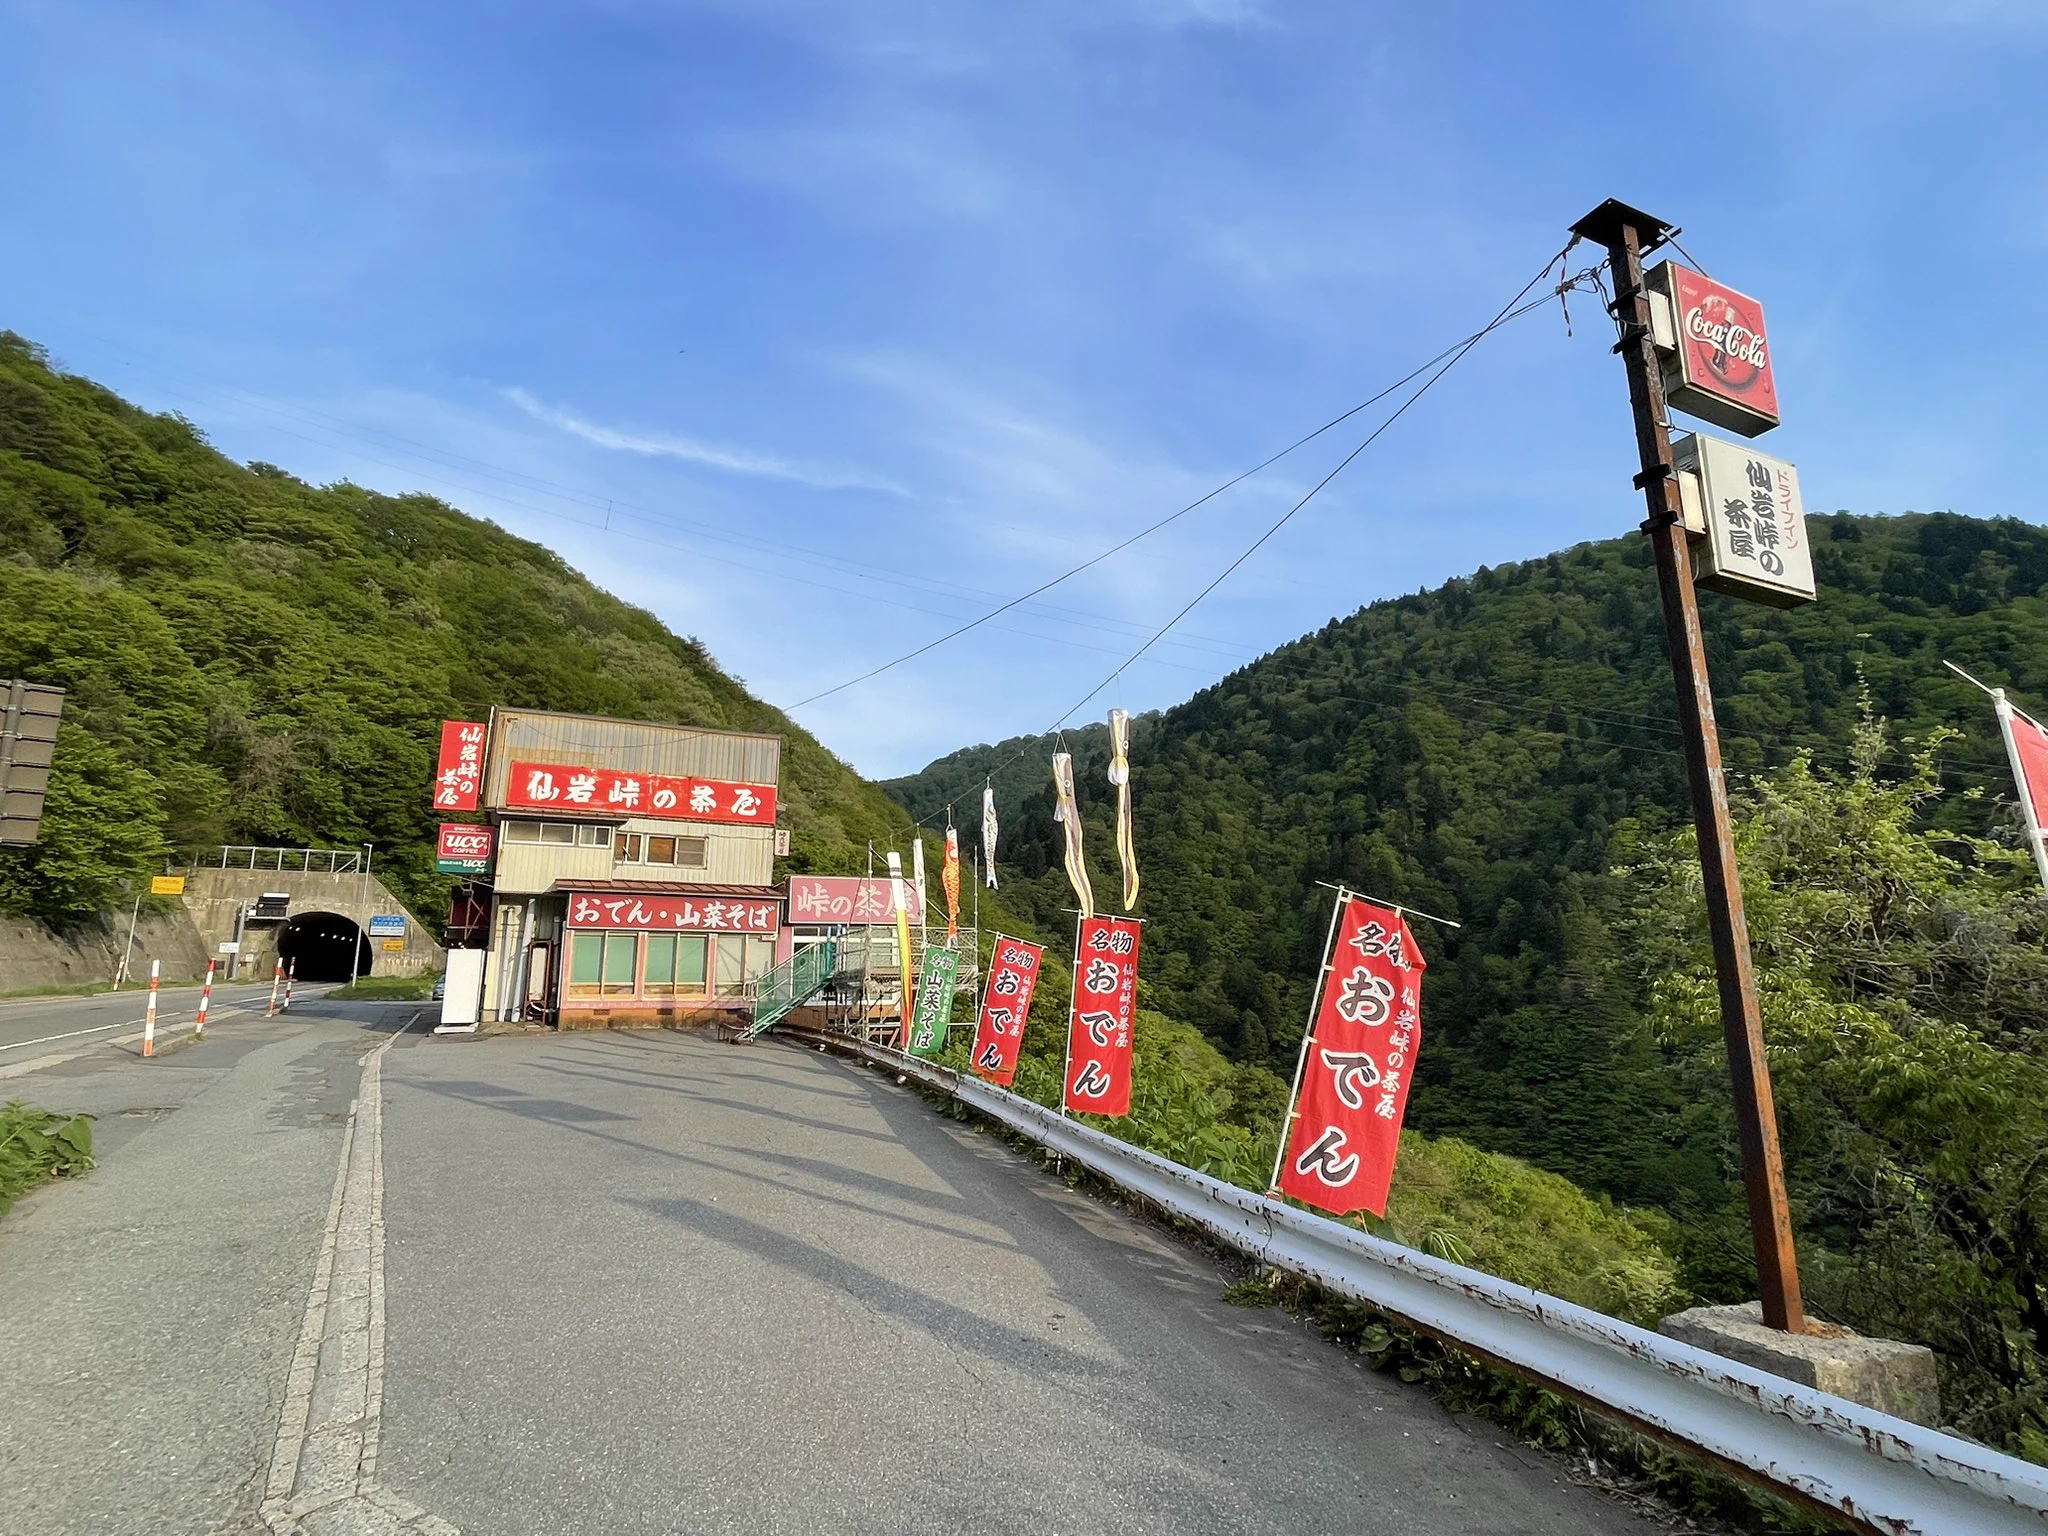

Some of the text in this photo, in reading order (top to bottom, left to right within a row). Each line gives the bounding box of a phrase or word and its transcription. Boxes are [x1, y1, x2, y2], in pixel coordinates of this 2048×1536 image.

[1685, 307, 1767, 369] Coca-Cola
[1723, 498, 1756, 560] 茶屋
[1745, 459, 1784, 576] 仙岩峠の
[437, 768, 461, 805] 茶屋
[457, 725, 482, 794] 仙岩峠の
[526, 770, 761, 816] 仙岩峠の茶屋
[574, 896, 775, 929] おでん・山菜そば
[796, 882, 917, 919] 峠の茶屋
[929, 953, 955, 971] 名物
[1000, 947, 1035, 969] 名物
[1088, 928, 1135, 955] 名物
[914, 969, 945, 1049] 山菜そば
[978, 967, 1021, 1070] おでん
[1073, 957, 1119, 1098] おでん
[1114, 963, 1134, 1048] 仙岩峠の茶屋
[1296, 965, 1395, 1188] おでん
[1374, 985, 1417, 1121] 仙岩峠の茶屋
